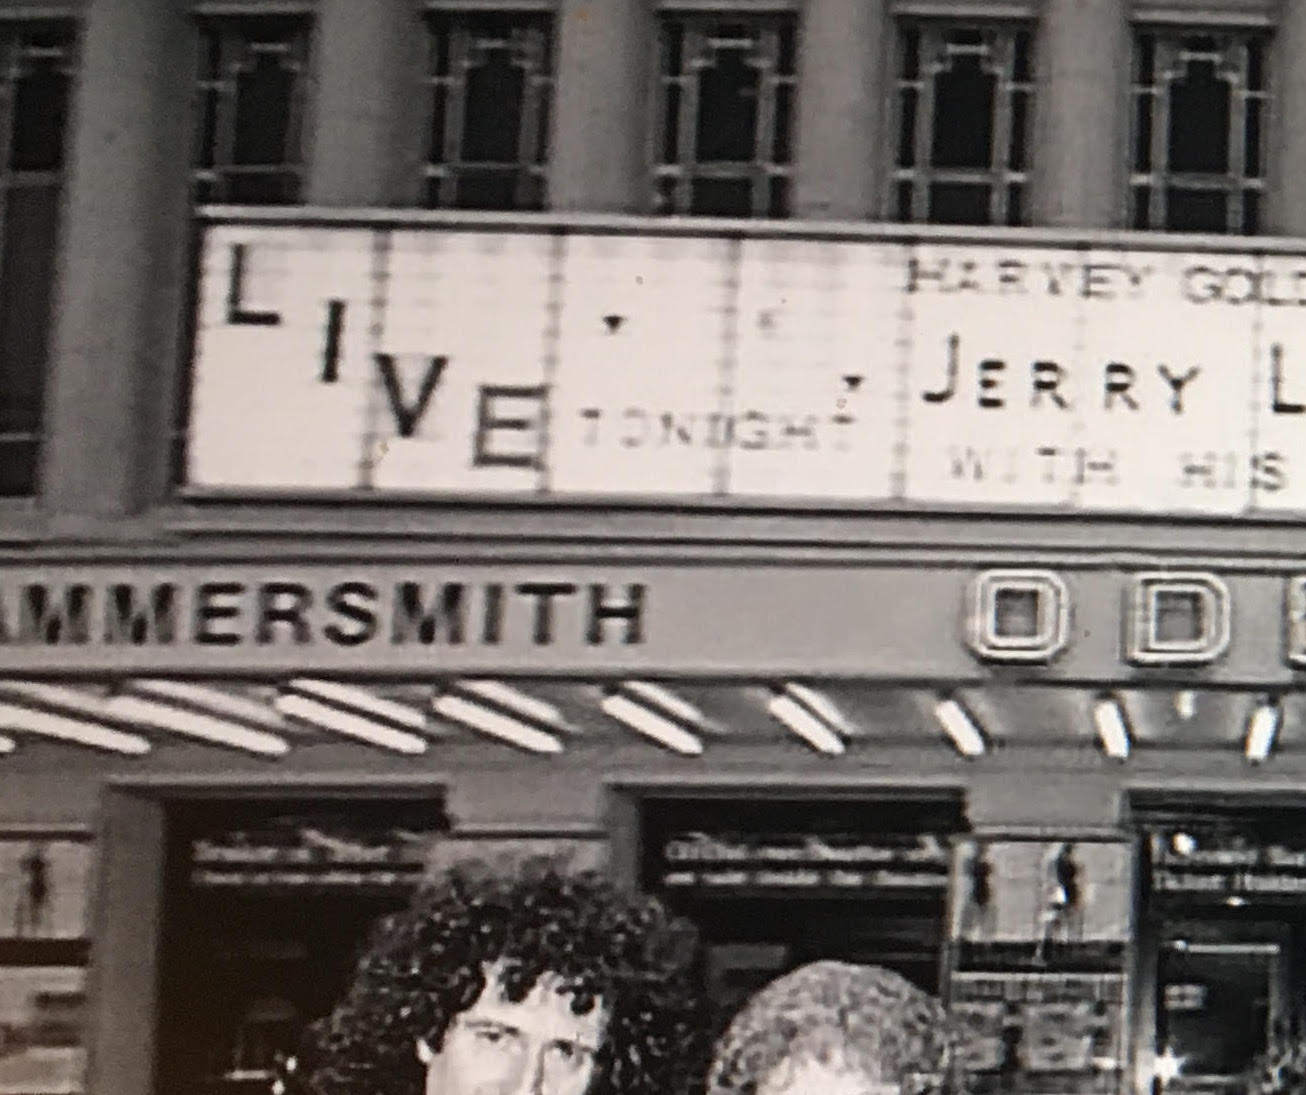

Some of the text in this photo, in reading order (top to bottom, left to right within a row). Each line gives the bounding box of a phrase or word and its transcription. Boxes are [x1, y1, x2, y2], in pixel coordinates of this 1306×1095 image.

[904, 257, 1153, 301] HARVEY
[228, 243, 553, 468] LIVE
[920, 330, 1200, 413] JERRY
[578, 406, 857, 451] TONIGHT
[948, 446, 1120, 487] WITH
[1176, 450, 1287, 492] HIS
[0, 580, 646, 648] MMERSMITH
